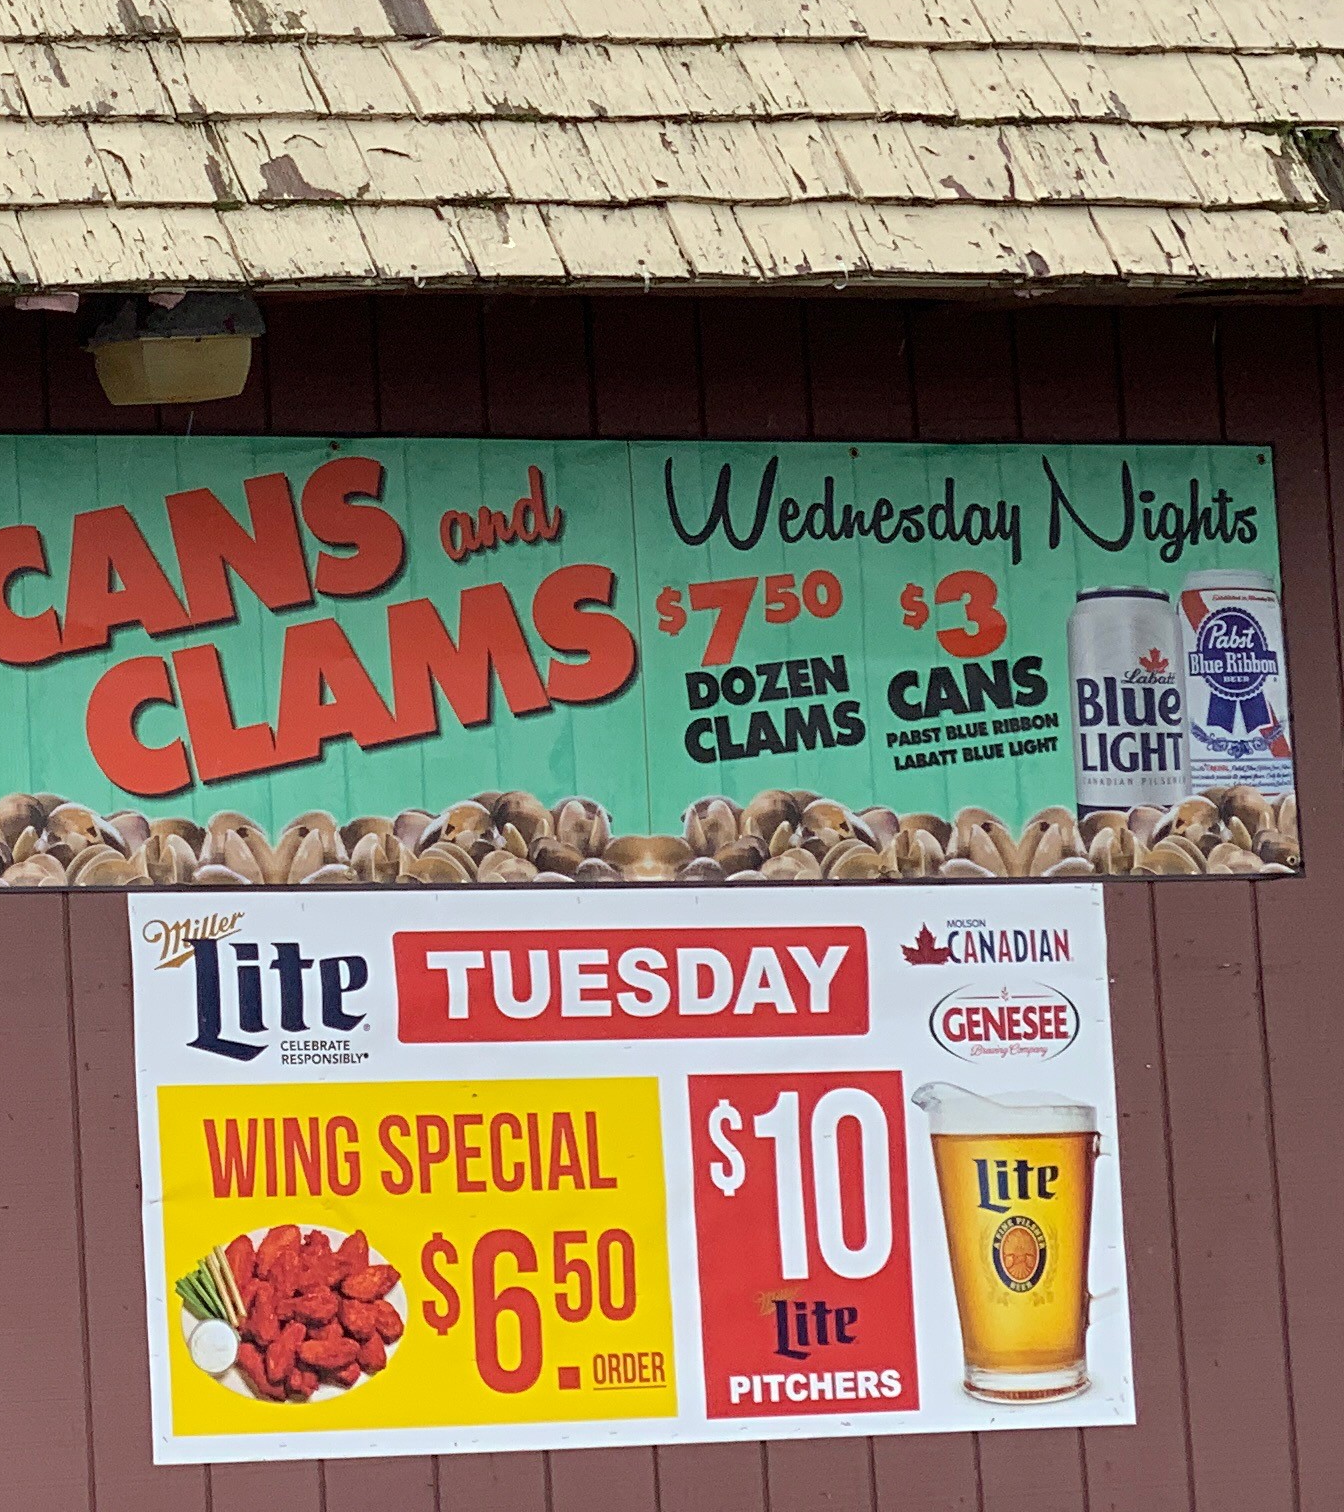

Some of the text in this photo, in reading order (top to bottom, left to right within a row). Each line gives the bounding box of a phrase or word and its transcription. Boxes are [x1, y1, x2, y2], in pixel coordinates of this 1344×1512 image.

[440, 465, 565, 562] and
[664, 454, 1258, 565] Wednesday Nights
[900, 569, 1008, 659] $3
[1206, 619, 1255, 649] Pabst
[87, 563, 638, 798] CLAMS
[685, 654, 851, 711] DOZEN
[887, 655, 1049, 722] CANS
[1121, 668, 1176, 685] Labatt
[1190, 651, 1278, 675] Blue Ribbon
[1076, 676, 1184, 727] Blue
[684, 700, 867, 764] CLAMS
[885, 712, 1060, 749] PABST BLUE RIBBON
[894, 735, 1059, 772] LABATT BLUE LIGHT
[1082, 732, 1184, 773] LIGHT
[143, 911, 245, 966] Miller
[946, 919, 987, 928] MOLSON
[946, 929, 1071, 964] CANADIAN
[182, 939, 369, 1062] Lite
[425, 945, 849, 1020] TUESDAY
[280, 1040, 351, 1052] CELEBRATE
[942, 1005, 1070, 1043] GENESEE
[1009, 1043, 1049, 1058] Company
[203, 1111, 618, 1199] WING SPECIAL
[709, 1088, 893, 1281] $10
[971, 1158, 1059, 1214] Lite
[771, 1299, 859, 1361] Lite
[592, 1350, 666, 1386] ORDER
[729, 1369, 902, 1404] PITCHERS
